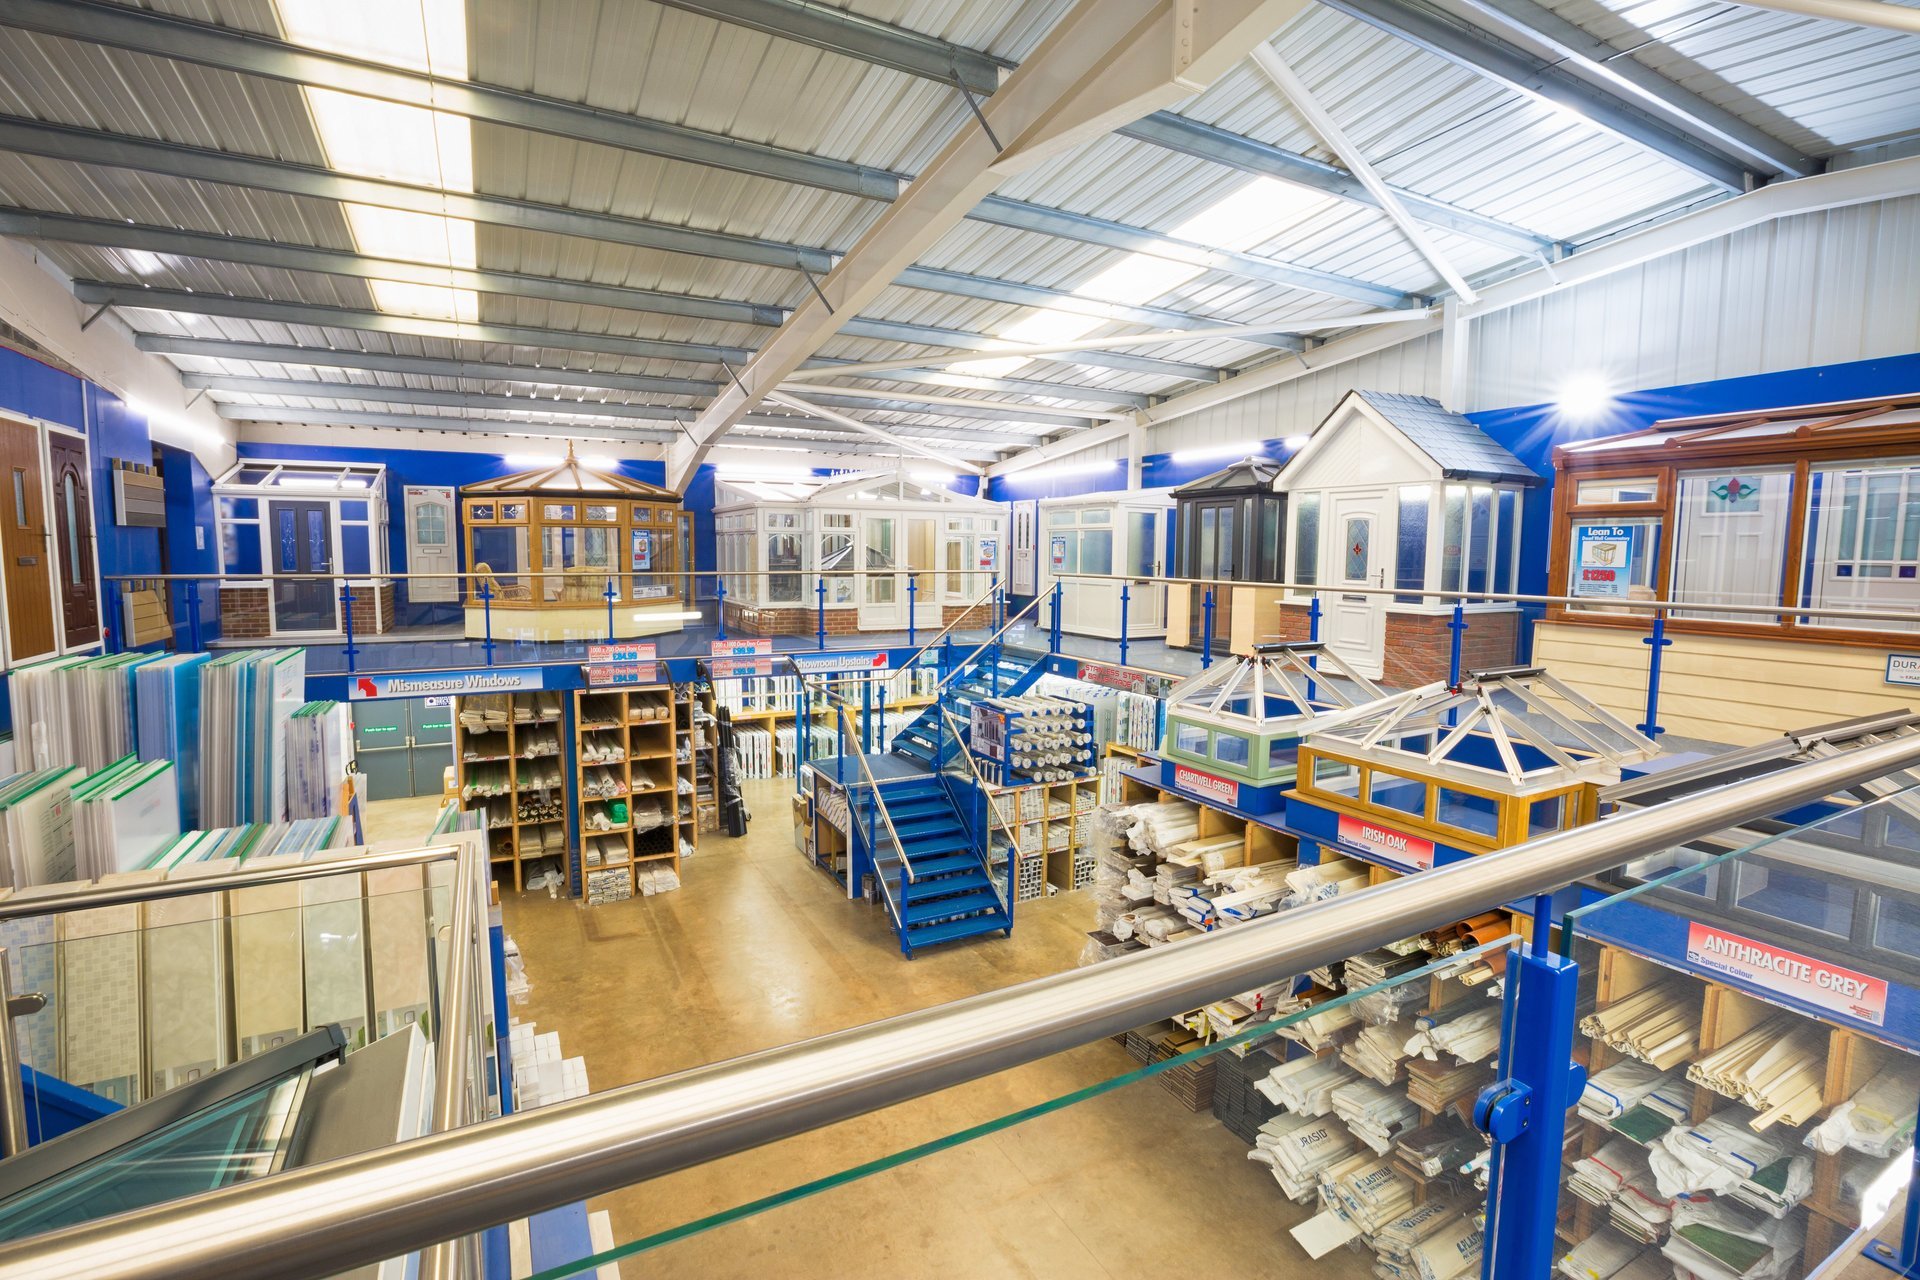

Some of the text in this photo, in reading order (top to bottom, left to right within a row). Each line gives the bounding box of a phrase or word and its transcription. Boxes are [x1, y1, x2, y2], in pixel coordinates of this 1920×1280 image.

[1588, 527, 1624, 536] Lean To
[613, 651, 637, 660] £84.99
[795, 656, 870, 669] Showroom Upstairs
[388, 673, 521, 693] Mismeasure Windows
[1085, 664, 1145, 683] STAINLESS STEEL
[1179, 769, 1234, 795] CHARTWELL GREEN
[1362, 826, 1407, 852] IRISH OAK
[1700, 956, 1753, 979] Special Colour
[1704, 933, 1869, 1000] ANTHRACITE GREY
